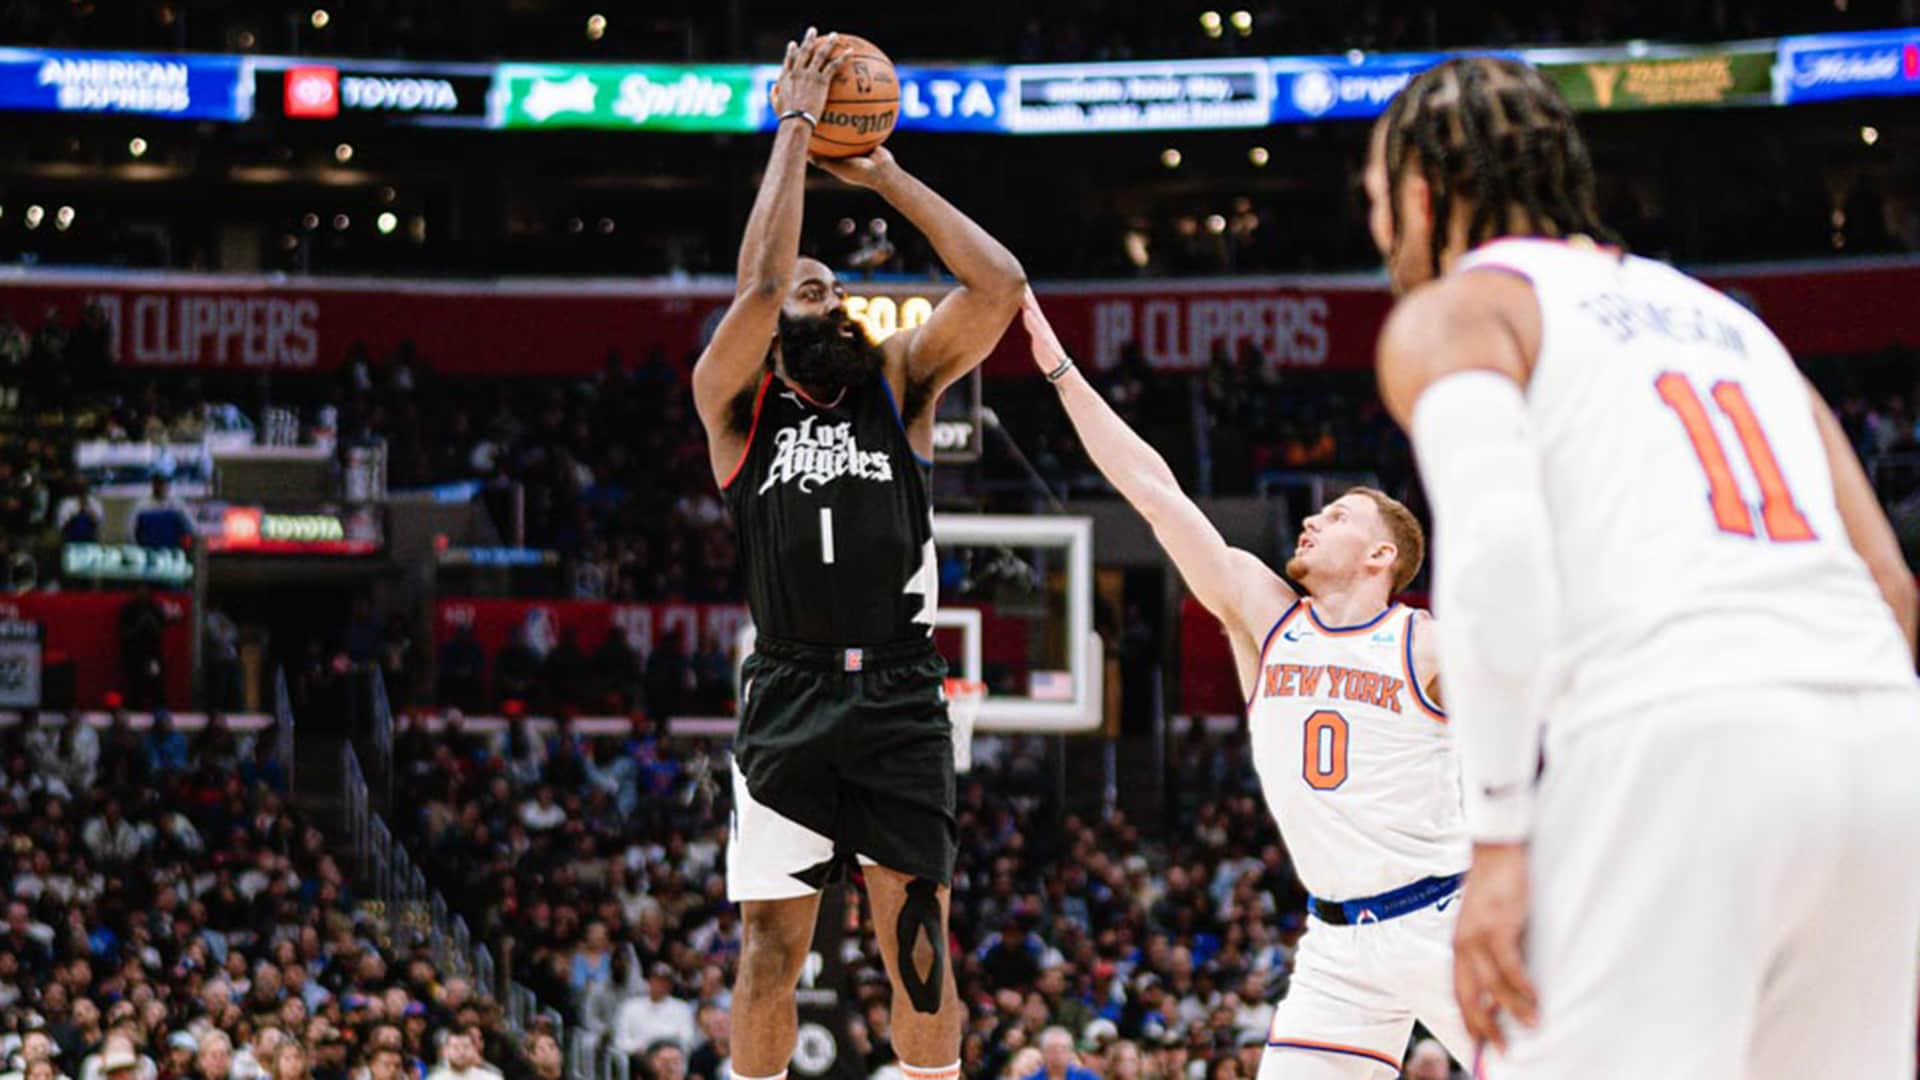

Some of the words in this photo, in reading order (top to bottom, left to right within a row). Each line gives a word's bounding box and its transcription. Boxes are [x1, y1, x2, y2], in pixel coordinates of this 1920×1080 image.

[39, 58, 188, 85] AMERICAN
[58, 83, 190, 111] EXPRESS
[341, 76, 458, 110] TOYOTA
[612, 73, 732, 123] Sprite
[902, 80, 995, 118] LTA
[134, 295, 319, 366] CLIPPERS
[1145, 297, 1329, 369] CLIPPERS
[795, 415, 852, 447] Los
[1653, 370, 1819, 542] 11
[758, 422, 893, 495] Angeles
[263, 514, 344, 541] TOYOTA
[819, 507, 835, 564] 1
[1263, 663, 1325, 699] NEW
[1326, 664, 1405, 715] YORK
[1302, 709, 1350, 791] 0
